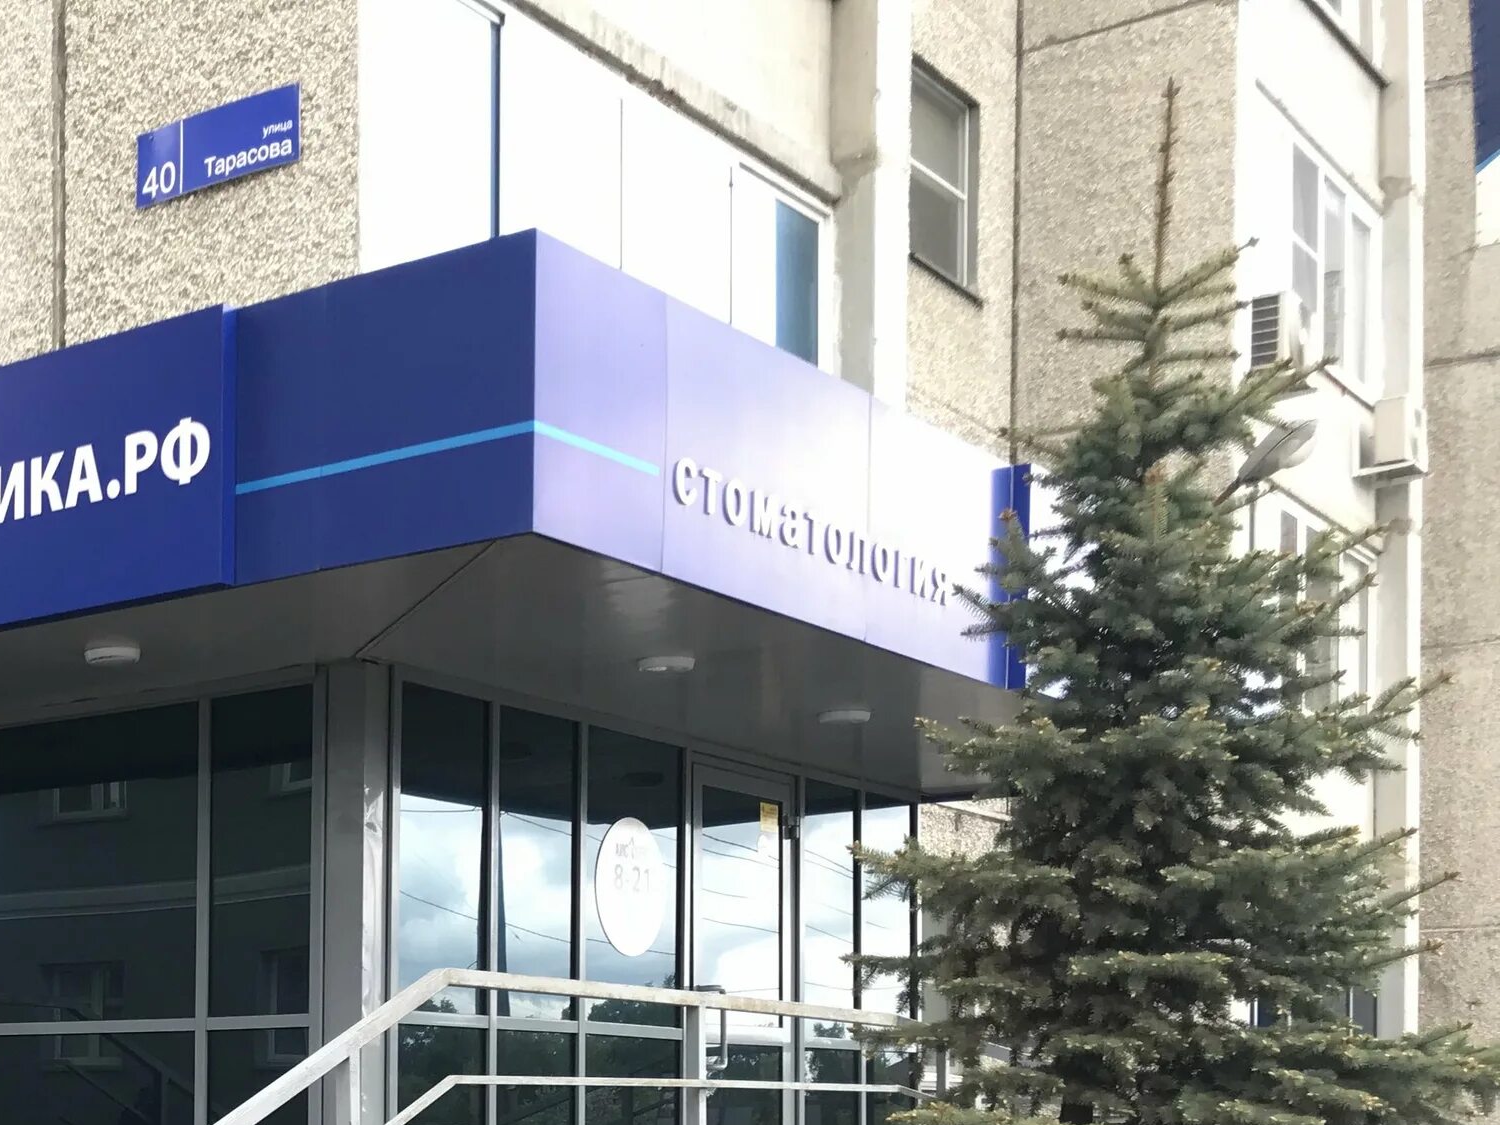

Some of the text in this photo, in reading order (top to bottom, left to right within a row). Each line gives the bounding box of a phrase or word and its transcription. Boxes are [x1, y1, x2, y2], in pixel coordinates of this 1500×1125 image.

[262, 119, 293, 139] улица
[204, 138, 293, 178] Тарасова
[142, 161, 176, 199] 40
